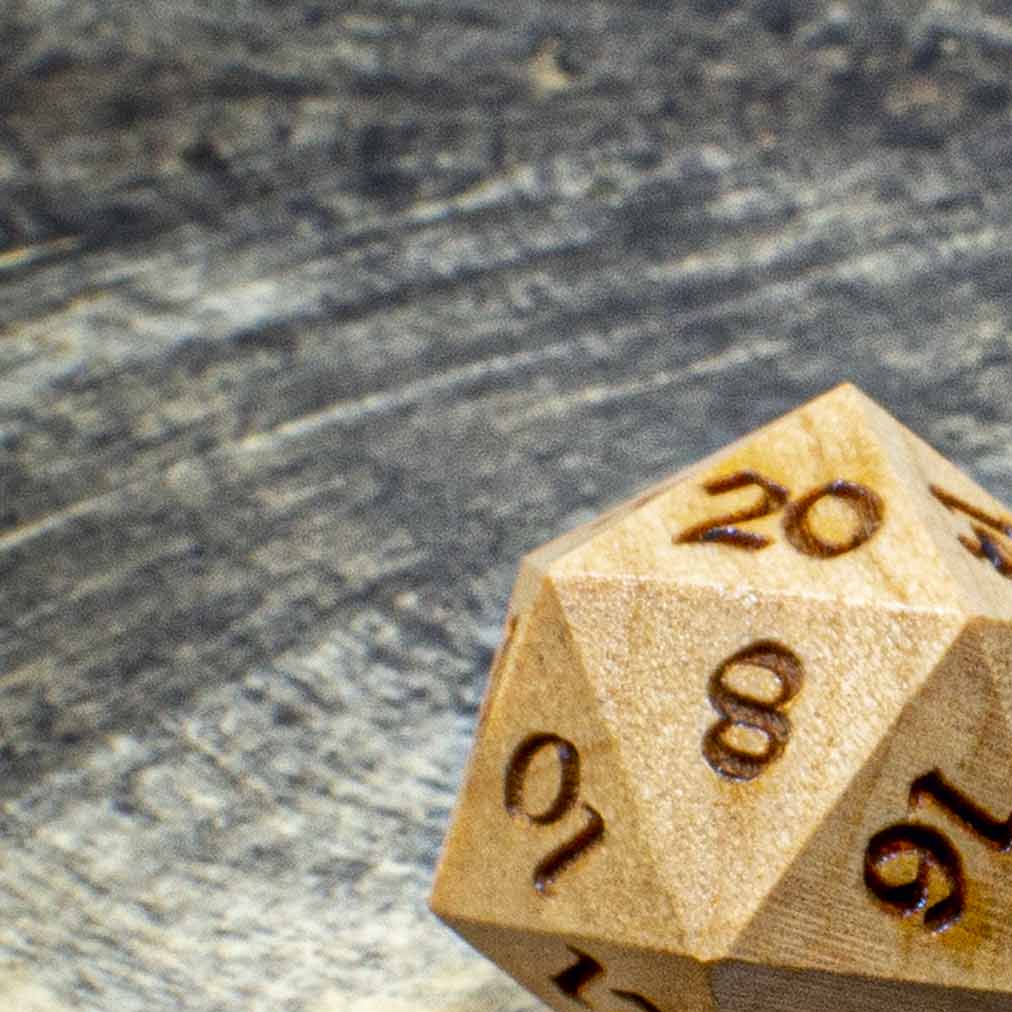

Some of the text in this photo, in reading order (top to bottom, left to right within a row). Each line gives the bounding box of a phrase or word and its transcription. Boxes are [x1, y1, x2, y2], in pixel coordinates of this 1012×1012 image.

[672, 470, 884, 559] 20
[702, 638, 806, 783] 8
[503, 732, 606, 895] 10
